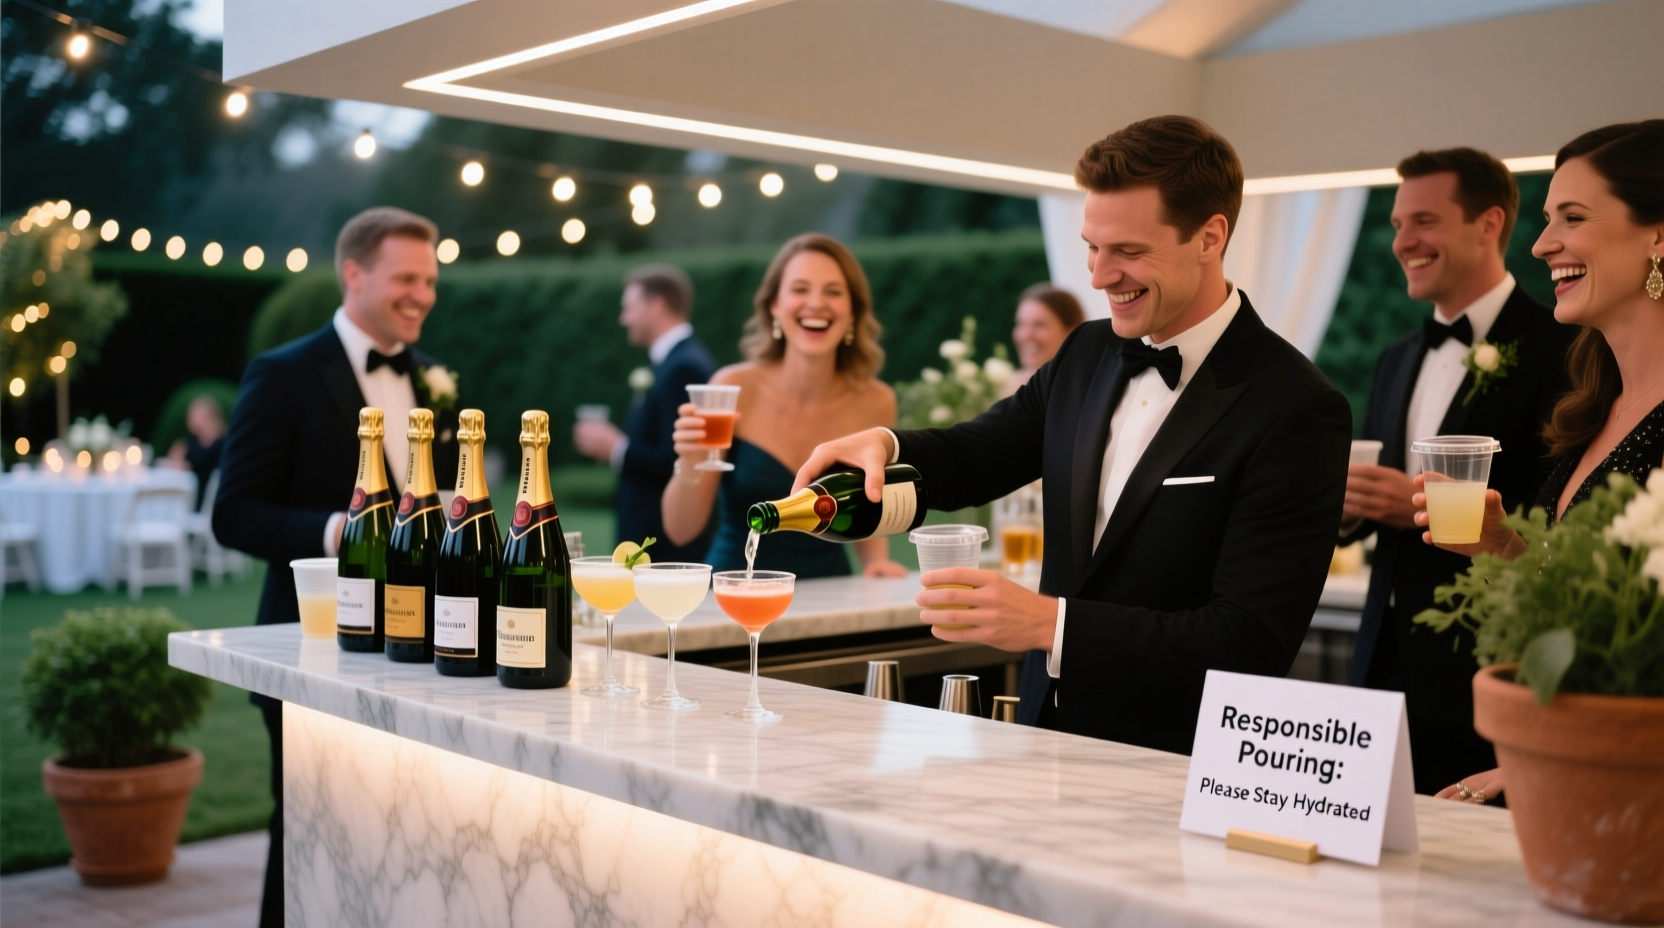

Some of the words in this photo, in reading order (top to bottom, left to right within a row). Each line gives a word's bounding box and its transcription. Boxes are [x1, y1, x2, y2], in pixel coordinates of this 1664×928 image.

[1220, 705, 1372, 749] Responsible
[1238, 740, 1344, 785] Pouring:
[1199, 777, 1250, 801] Please
[1253, 786, 1289, 812] Stay
[1293, 792, 1371, 822] Hydrated
